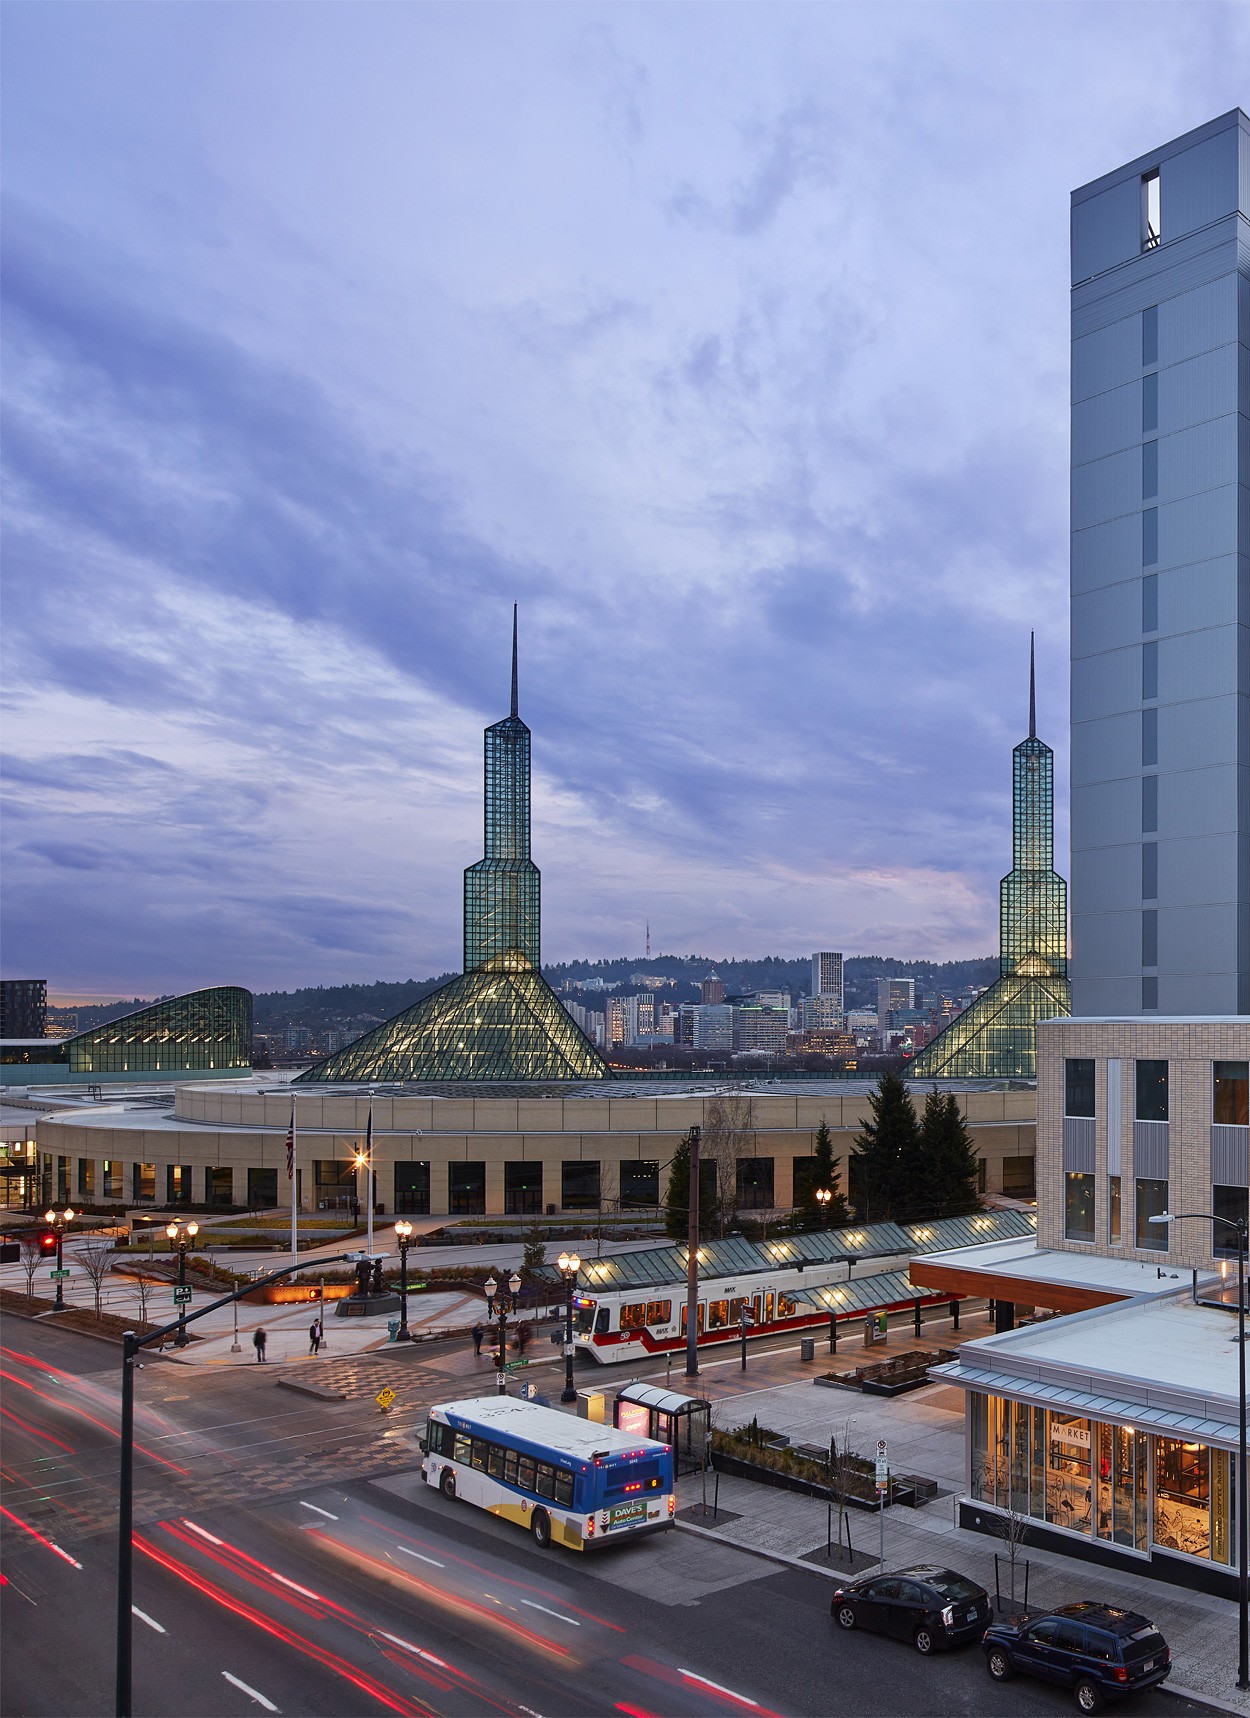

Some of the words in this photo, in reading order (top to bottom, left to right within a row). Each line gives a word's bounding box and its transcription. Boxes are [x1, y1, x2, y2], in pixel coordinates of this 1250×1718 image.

[1053, 1425, 1089, 1440] MARKET
[651, 1479, 657, 1487] 6
[615, 1505, 643, 1517] DAVE'S
